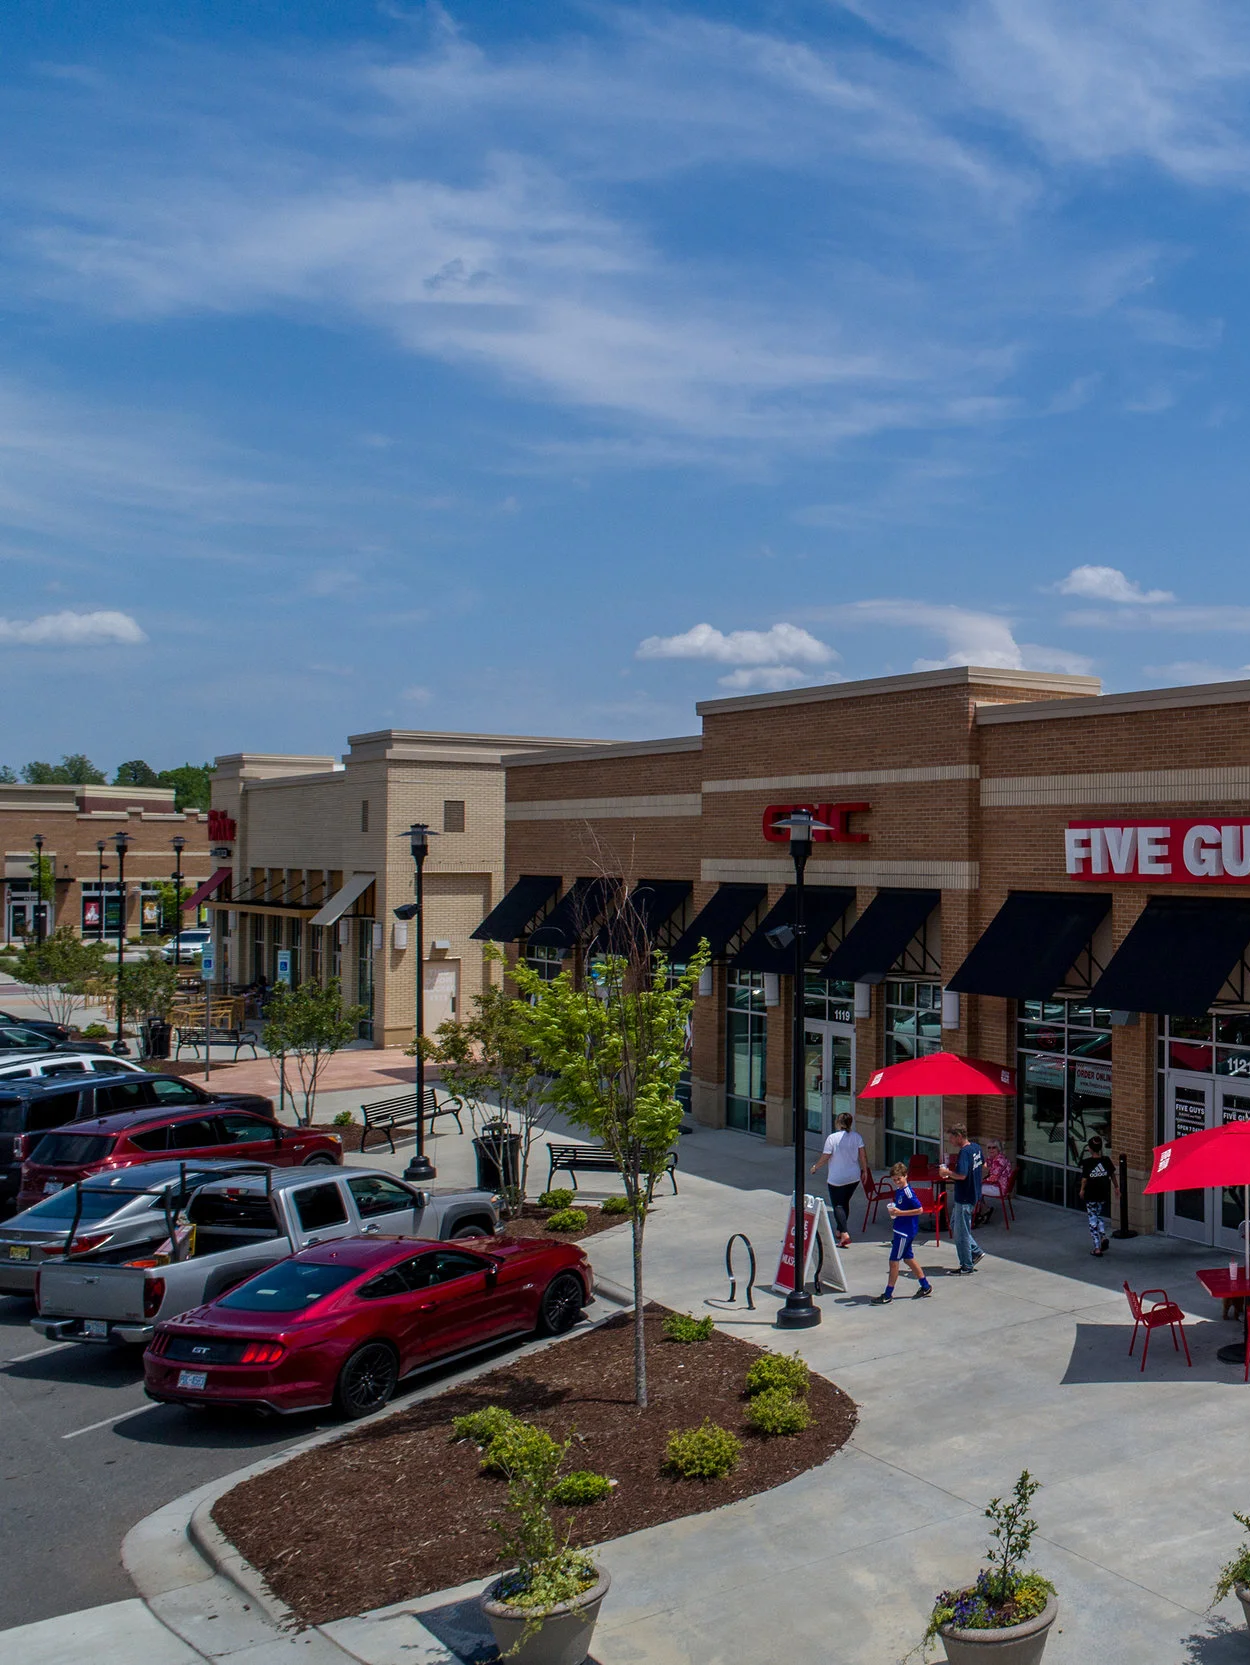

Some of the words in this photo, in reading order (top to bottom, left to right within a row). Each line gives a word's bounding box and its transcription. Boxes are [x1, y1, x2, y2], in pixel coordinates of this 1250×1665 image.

[1065, 826, 1172, 875] FIVE
[834, 1009, 851, 1022] 1119
[1077, 1069, 1095, 1080] ORDER
[1096, 1072, 1112, 1082] ONLIN
[1176, 1104, 1188, 1112] FIVE
[1189, 1106, 1205, 1115] GUYS
[1223, 1112, 1236, 1121] FIVE
[192, 1346, 211, 1354] GT
